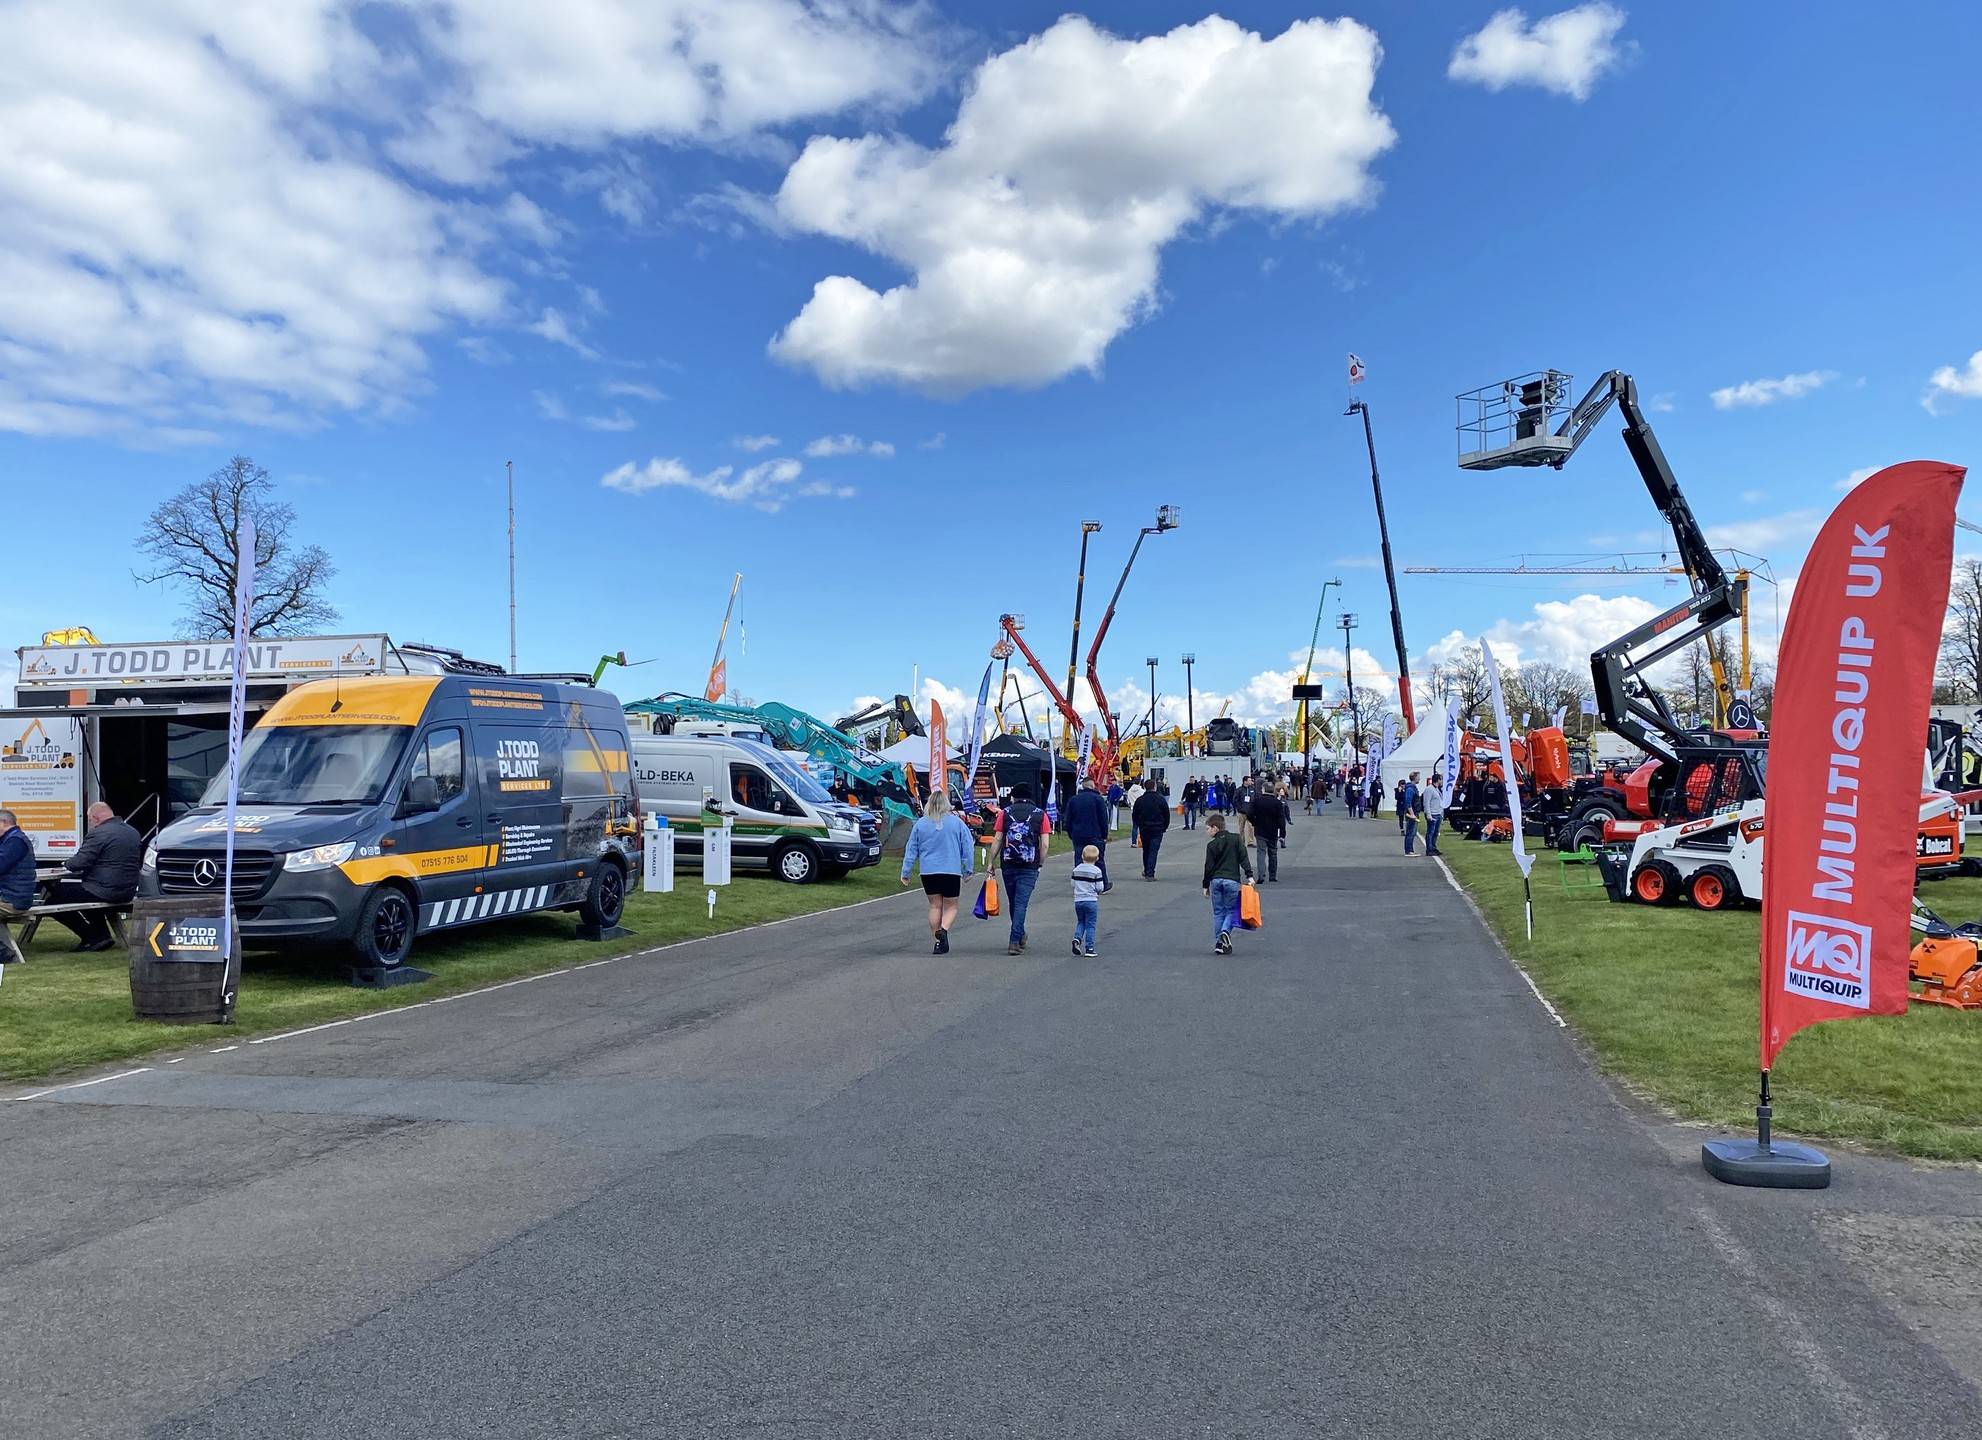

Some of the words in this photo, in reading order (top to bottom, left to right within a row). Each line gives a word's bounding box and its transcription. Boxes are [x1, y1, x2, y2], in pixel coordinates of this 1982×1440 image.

[1653, 607, 1691, 635] MANITOU
[64, 650, 170, 675] J.TODD
[183, 645, 283, 672] PLANT
[1811, 616, 1876, 905] MULTIQUIP
[1846, 523, 1890, 598] UK
[27, 745, 60, 754] J.TODD
[31, 754, 60, 762] PLANT
[496, 740, 539, 759] J.TODD
[499, 760, 539, 778] PLANT
[1926, 838, 1952, 854] Bobcat
[169, 926, 217, 937] J.TODD
[175, 936, 217, 946] PLANT
[1789, 971, 1862, 999] MULTIQUIP
